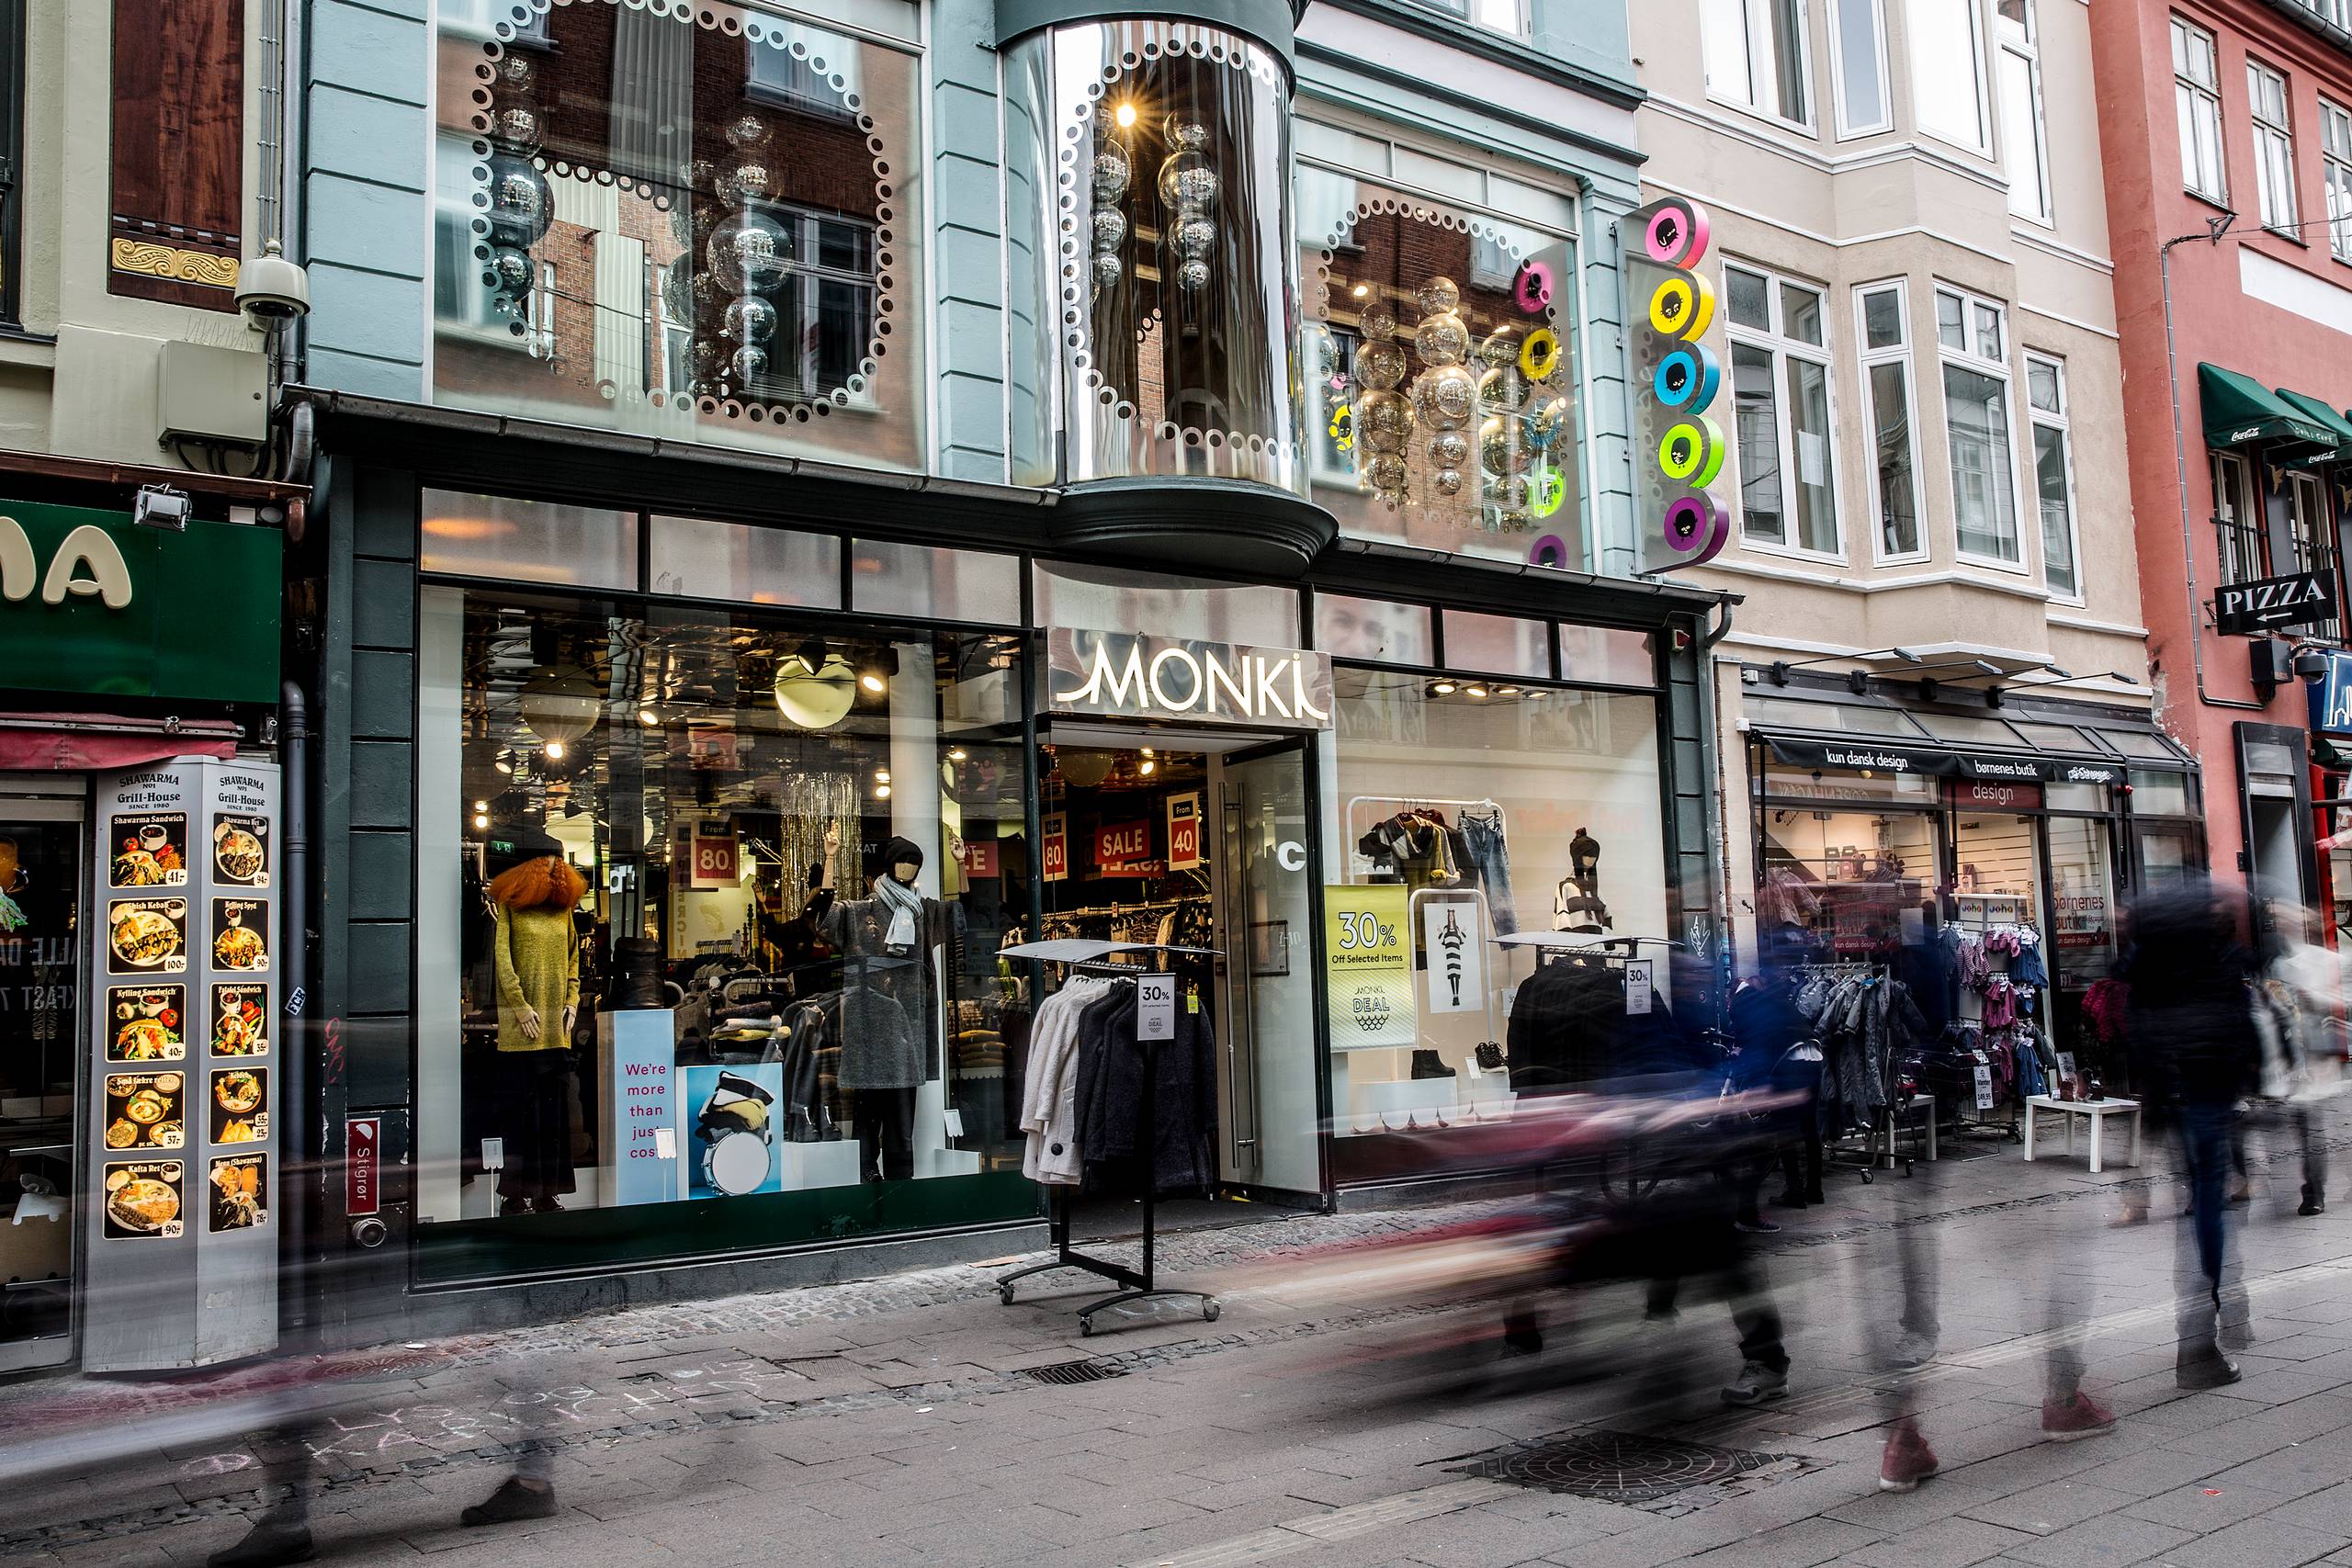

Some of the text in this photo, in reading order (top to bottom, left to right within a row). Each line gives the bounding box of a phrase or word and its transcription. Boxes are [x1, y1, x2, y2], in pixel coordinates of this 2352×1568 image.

[2223, 578, 2326, 615] PIZZA
[1825, 749, 1908, 771] kun dansk design
[1974, 760, 2037, 777] børnenes butik
[119, 773, 179, 788] SHAWARMA
[220, 776, 265, 791] SHAWARMA
[118, 793, 181, 804] Grill-House
[219, 793, 266, 807] Grill-House
[1973, 784, 2014, 806] design
[114, 817, 150, 825] Shawarma
[223, 817, 251, 825] Shawarma
[1102, 829, 1143, 857] SALE
[1339, 911, 1396, 950] 30%
[1332, 953, 1403, 964] Off Selected Items
[1629, 970, 1648, 982] 30%
[142, 987, 176, 996] Sandwich
[1142, 987, 1170, 1001] 30%
[1352, 998, 1390, 1013] DEAL
[625, 1064, 666, 1076] We're
[628, 1086, 665, 1096] more
[629, 1104, 663, 1117] than
[632, 1126, 659, 1141] jus
[630, 1148, 660, 1160] cos
[129, 1165, 148, 1173] Kafta
[354, 1147, 369, 1201] Stigrør
